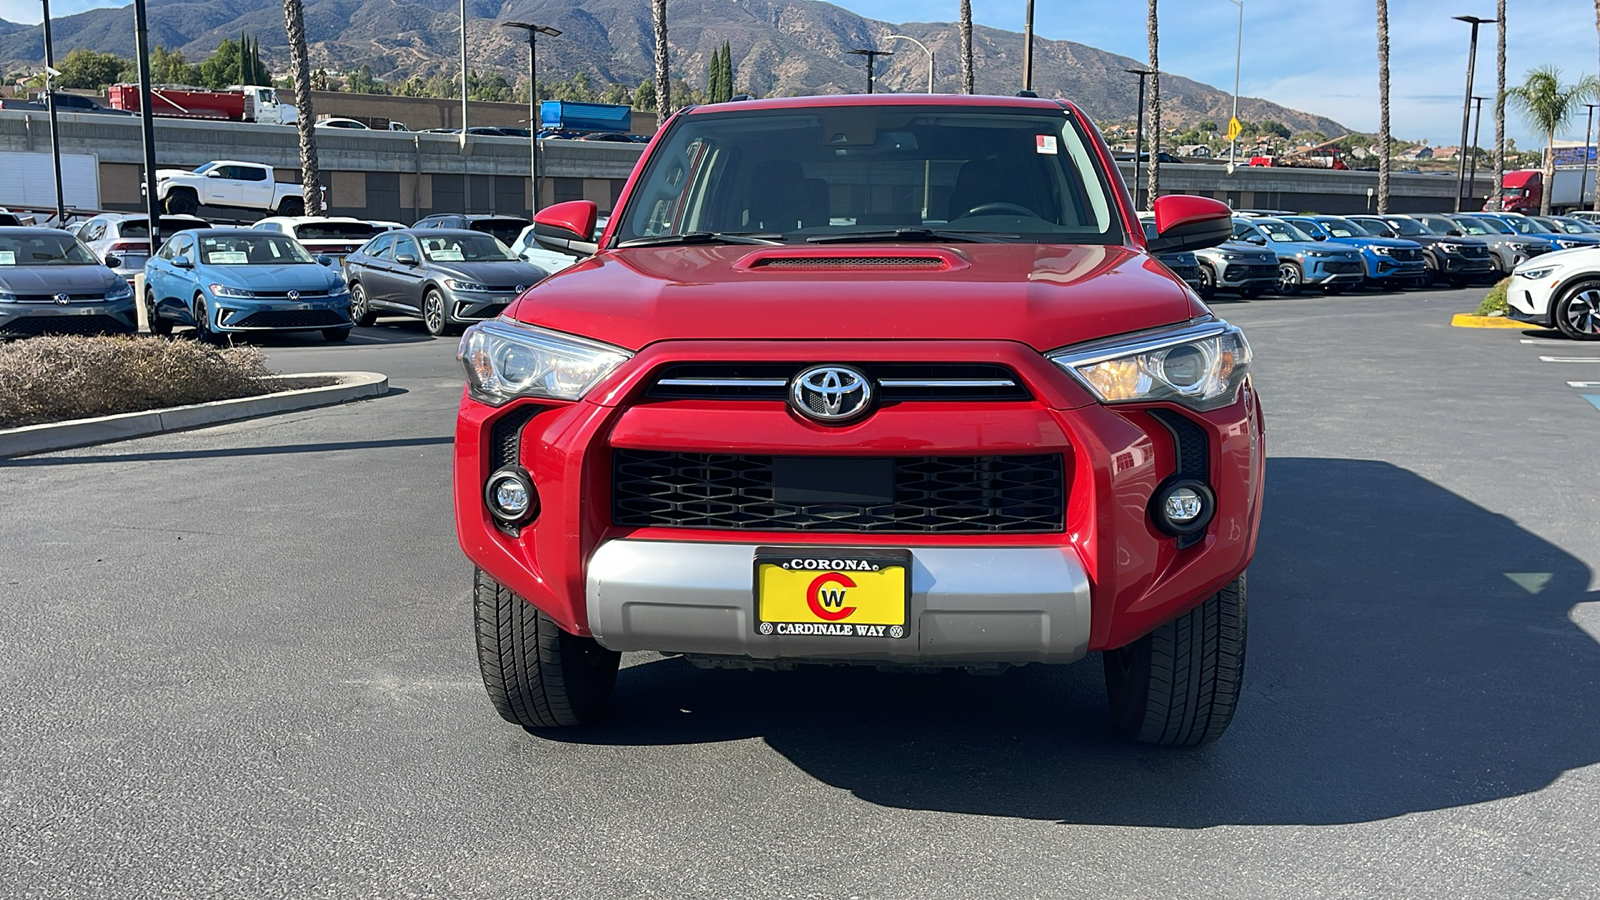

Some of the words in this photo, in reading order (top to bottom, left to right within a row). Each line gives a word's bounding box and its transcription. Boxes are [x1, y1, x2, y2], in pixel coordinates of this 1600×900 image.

[790, 558, 870, 571] CORONA
[776, 623, 853, 636] CARDINALE
[856, 625, 886, 637] WAY
